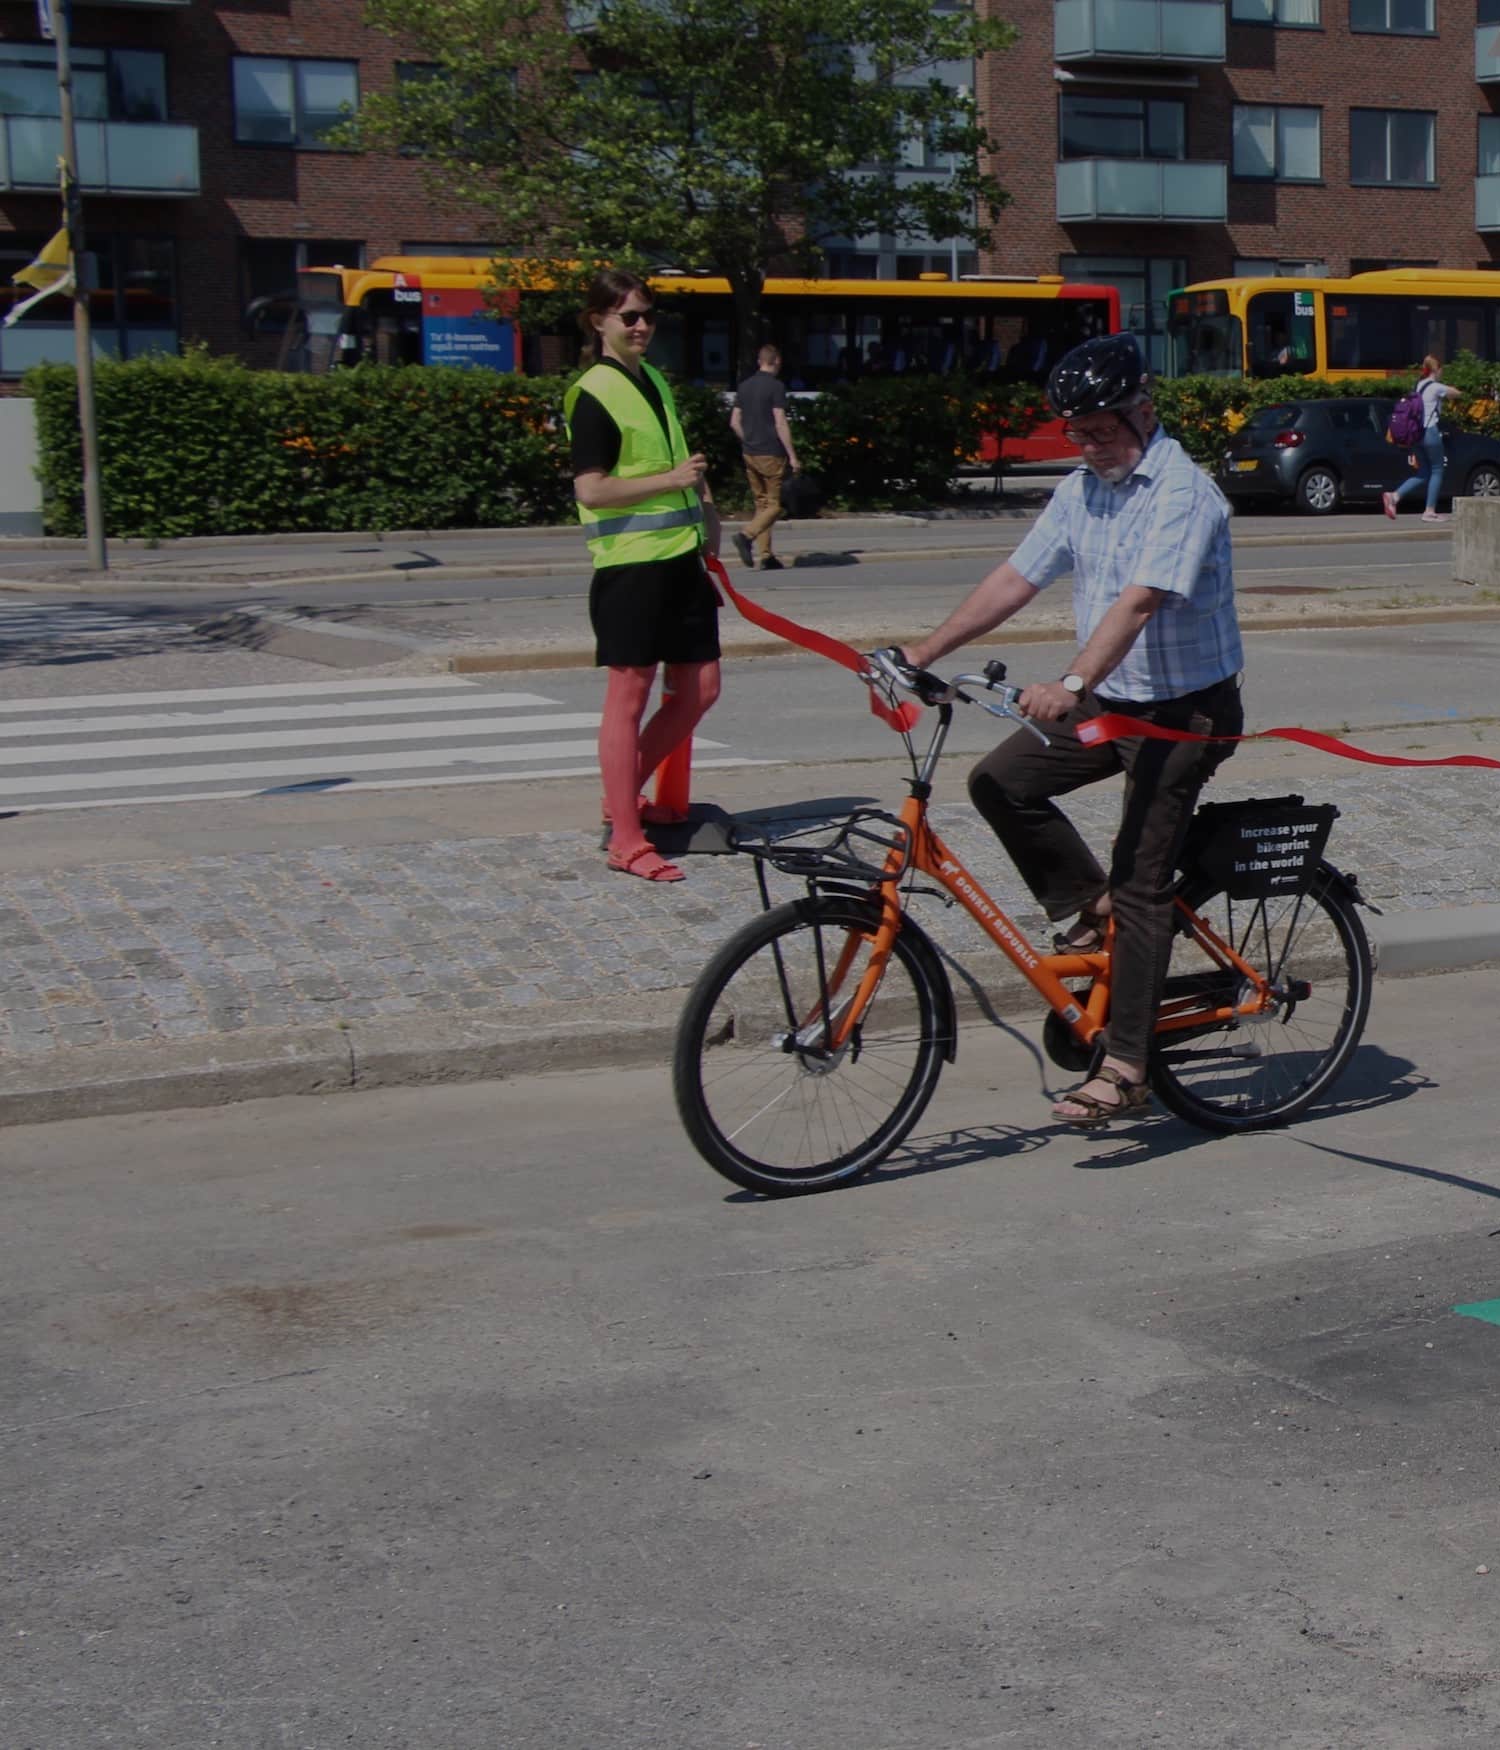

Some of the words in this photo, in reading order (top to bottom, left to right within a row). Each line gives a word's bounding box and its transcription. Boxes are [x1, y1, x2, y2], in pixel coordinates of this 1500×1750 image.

[395, 274, 407, 287] A
[394, 288, 422, 302] bus
[1294, 292, 1302, 305] E
[1295, 305, 1314, 316] bus
[1240, 825, 1290, 838] Increase
[1291, 823, 1319, 836] your
[1256, 839, 1310, 854] bikeprint
[1235, 861, 1246, 872] in
[1248, 860, 1269, 871] the
[1270, 855, 1304, 869] world
[955, 876, 996, 919] DONKEY
[992, 918, 1039, 969] REPUBLIC
